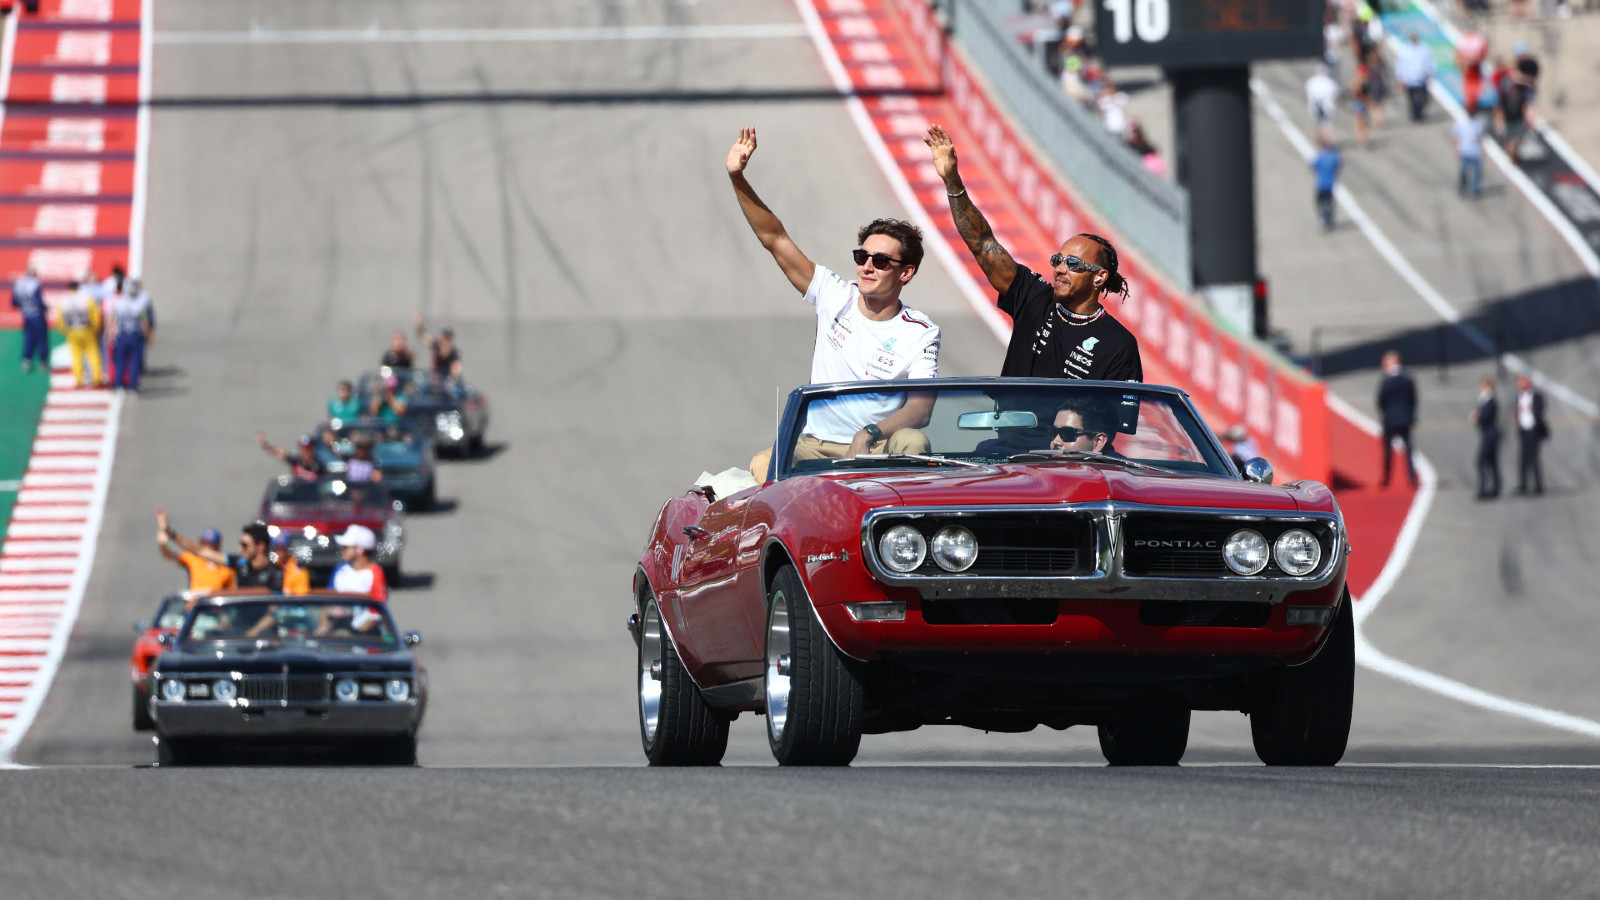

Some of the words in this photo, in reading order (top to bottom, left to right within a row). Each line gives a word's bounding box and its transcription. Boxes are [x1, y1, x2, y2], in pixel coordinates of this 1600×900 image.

[1103, 0, 1170, 43] 10
[1069, 351, 1093, 367] INEOS
[1134, 539, 1217, 548] PONTIAC
